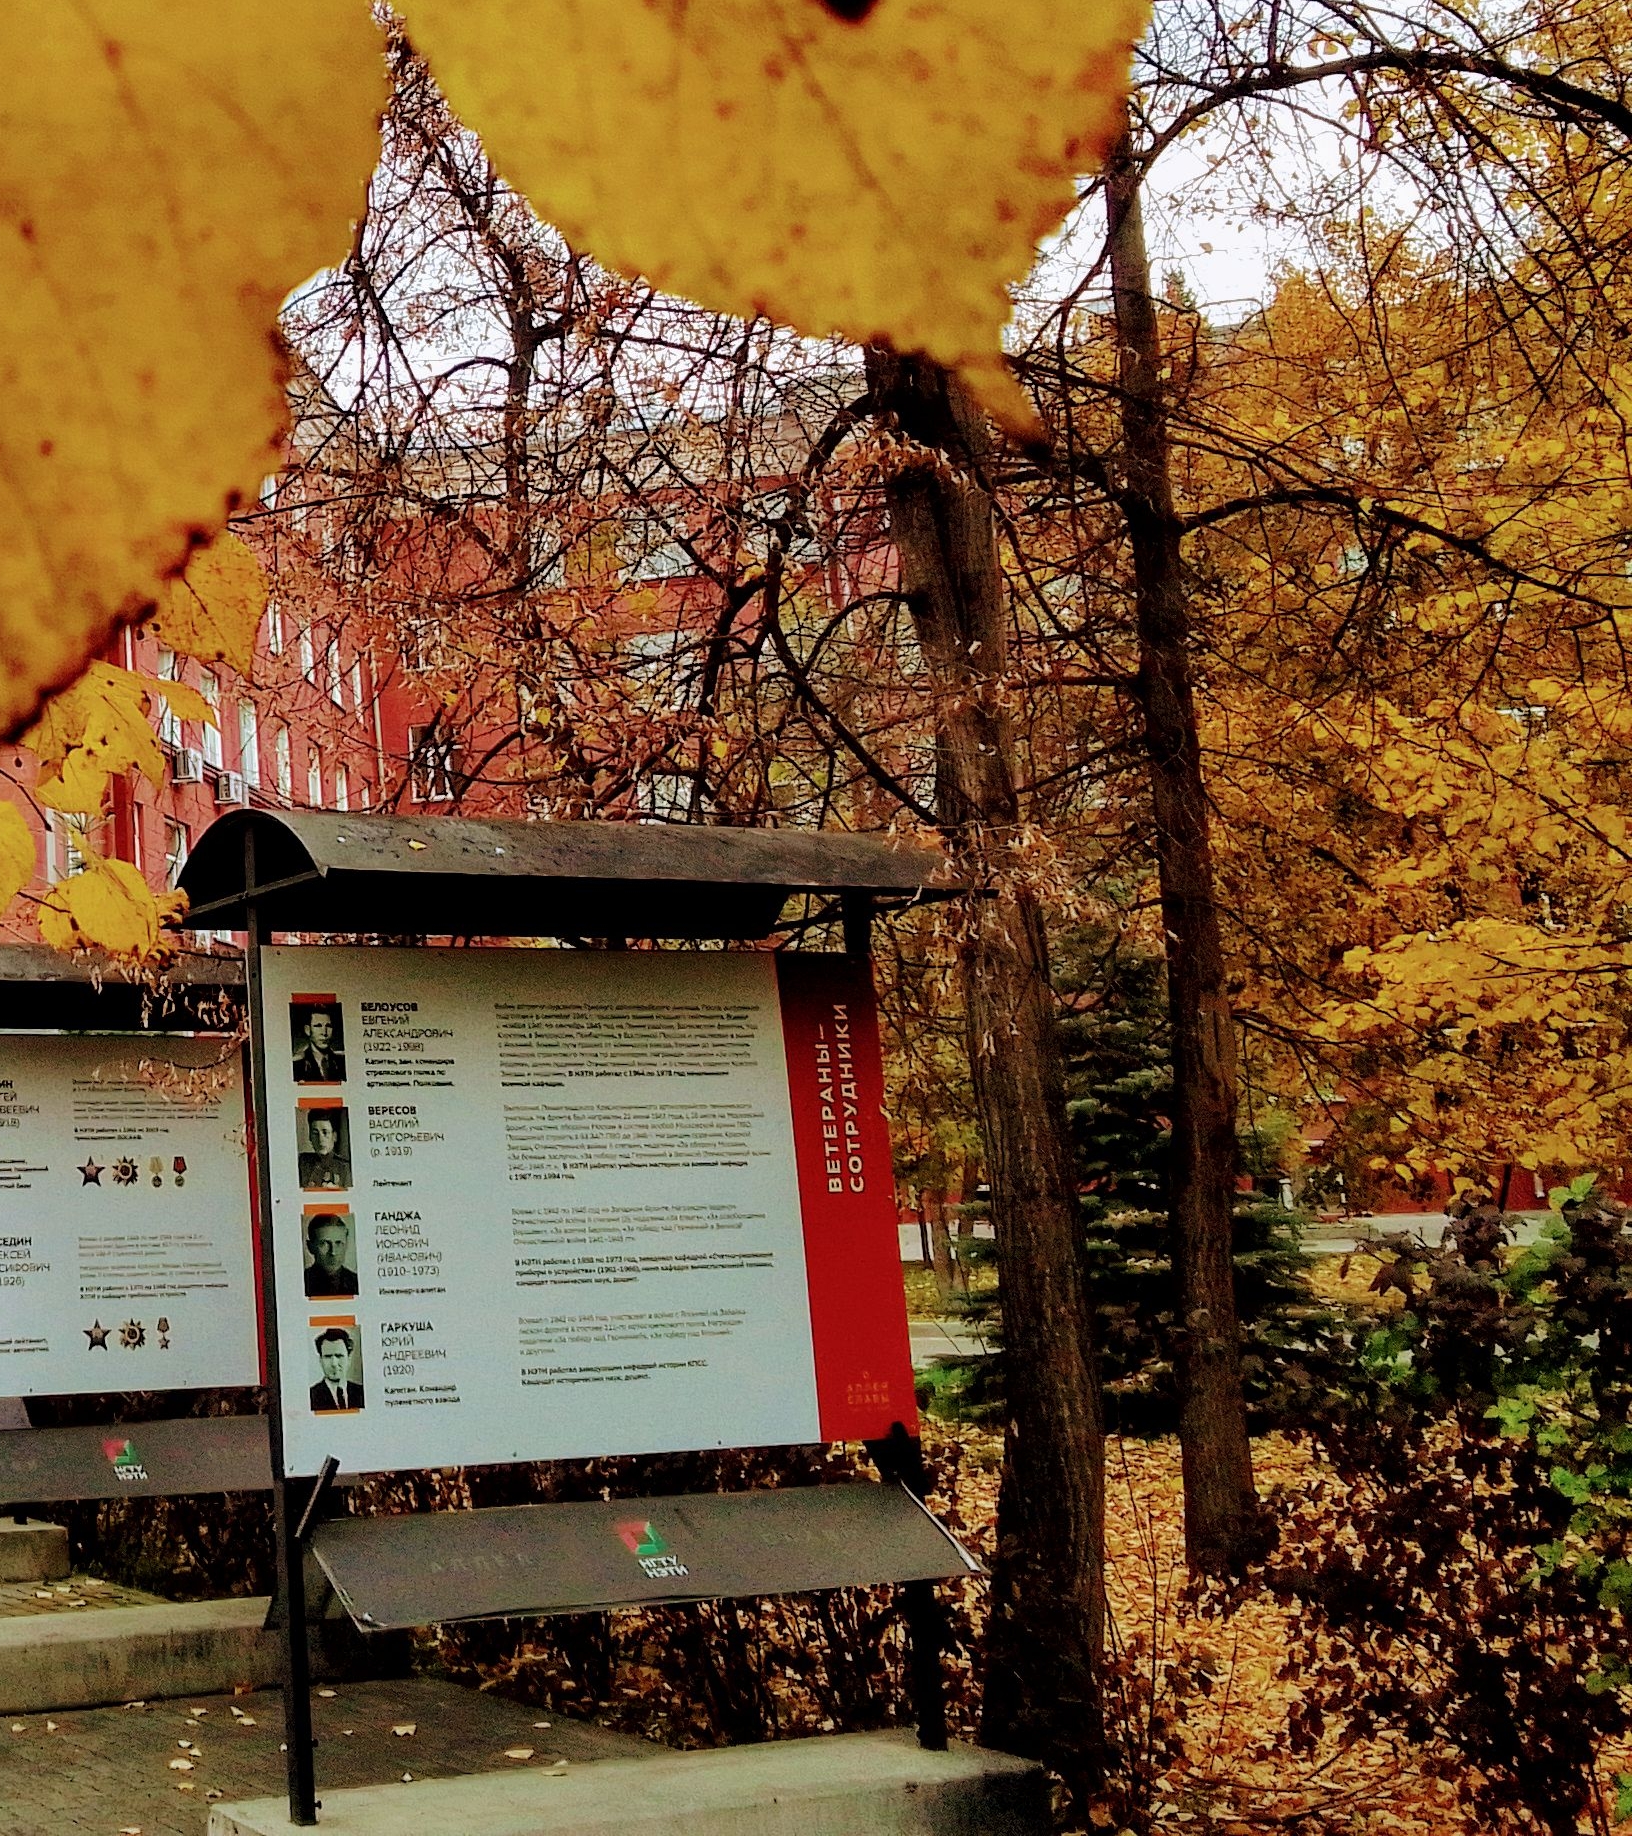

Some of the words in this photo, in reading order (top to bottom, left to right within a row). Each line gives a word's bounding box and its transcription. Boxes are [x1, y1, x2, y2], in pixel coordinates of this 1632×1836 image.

[361, 1002, 418, 1011] БЕЛОУСОВ
[362, 1014, 409, 1025] ЕВГЕНИЙ
[363, 1028, 454, 1038] АЛЕКСАНДРОВИЧ
[833, 1004, 865, 1193] СОТРУДНИКИ
[368, 1106, 417, 1115] ВЕРЕСОВ
[369, 1117, 419, 1129] ВАСИЛИЙ
[369, 1132, 444, 1142] ГРИГОРЬЕВИЧ
[374, 1211, 422, 1221] ГАНДЖА
[375, 1224, 421, 1235] ЛЕОНИД
[376, 1238, 429, 1249] ИОНОВИЧ
[377, 1251, 442, 1264] (ИВАНОВИЧ)
[381, 1321, 434, 1333] ГАРКУША
[381, 1334, 414, 1347] ЮРИЙ
[382, 1349, 447, 1361] АНДРЕЕВИЧ
[639, 1555, 677, 1569] НГТУ
[646, 1564, 689, 1579] НЭТИ
